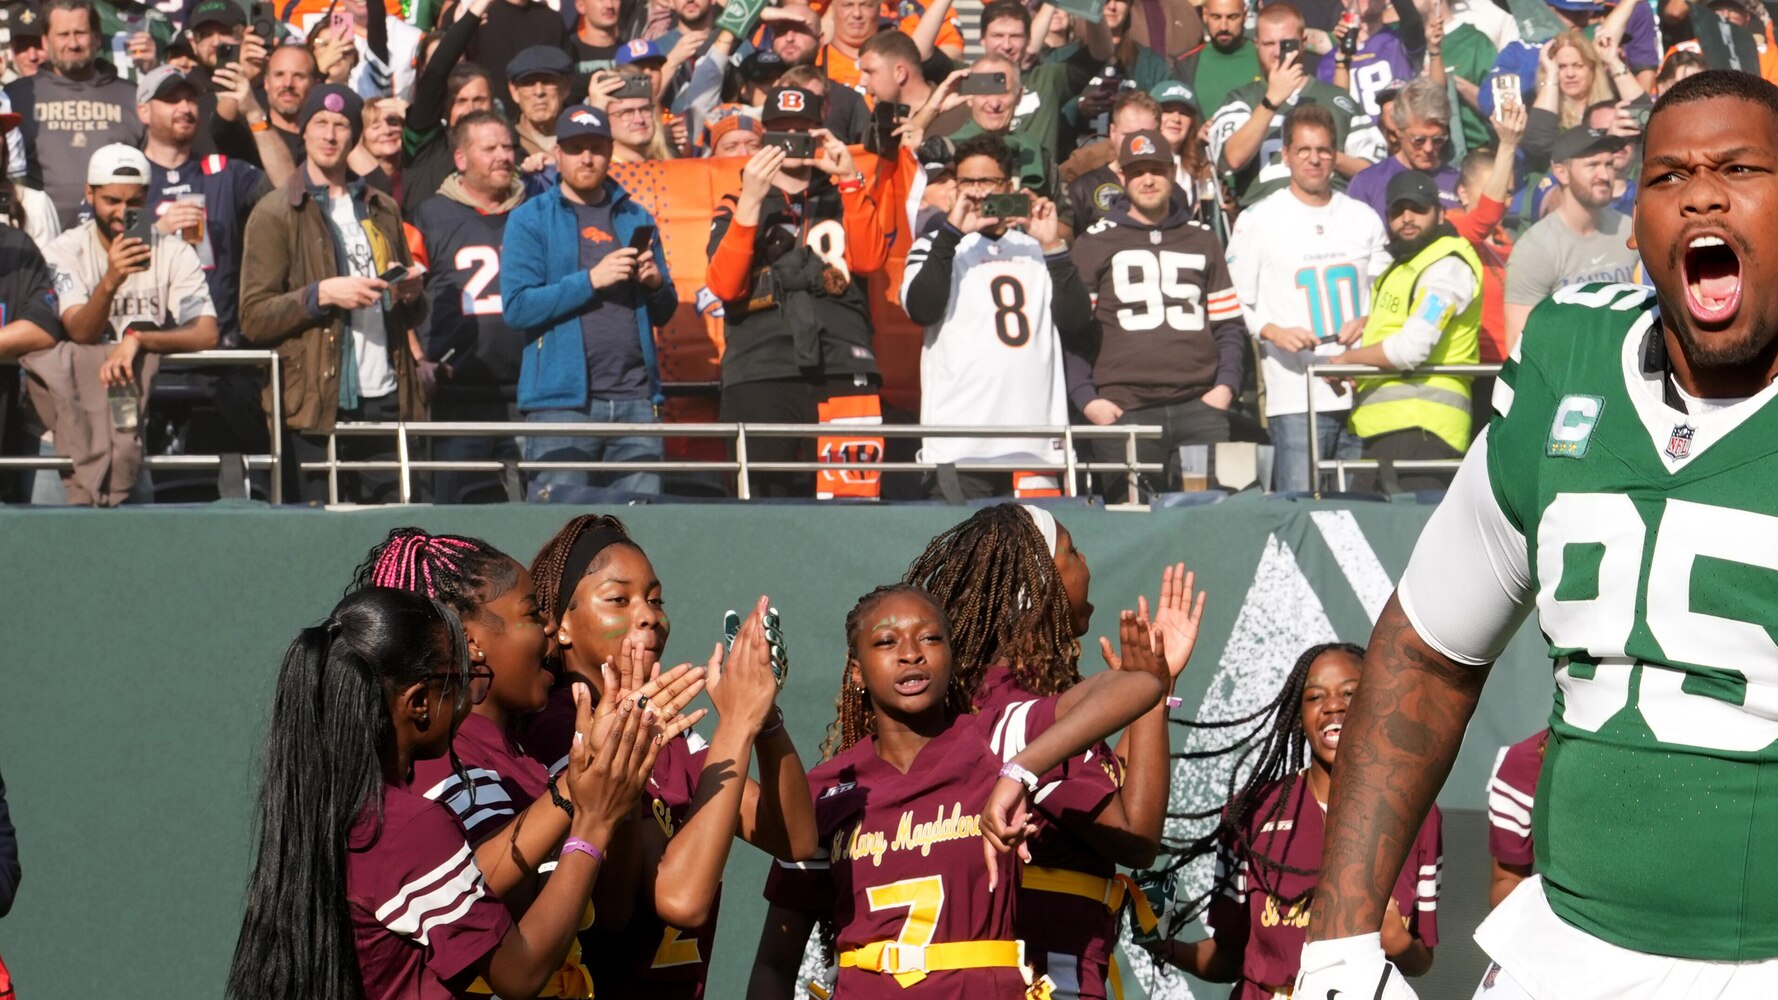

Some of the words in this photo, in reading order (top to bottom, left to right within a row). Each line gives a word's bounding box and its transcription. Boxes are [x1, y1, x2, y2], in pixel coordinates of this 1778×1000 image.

[34, 100, 121, 123] OREGON
[48, 120, 109, 131] DUCKS
[778, 90, 804, 111] B
[455, 244, 503, 316] 2
[1112, 249, 1206, 331] 95
[1295, 263, 1361, 338] 10
[990, 274, 1031, 348] 8
[1551, 396, 1599, 441] C
[1667, 437, 1688, 455] NFL
[820, 781, 857, 799] JETS
[842, 819, 888, 867] Mary
[891, 801, 982, 857] Magdalene
[866, 874, 945, 948] 7
